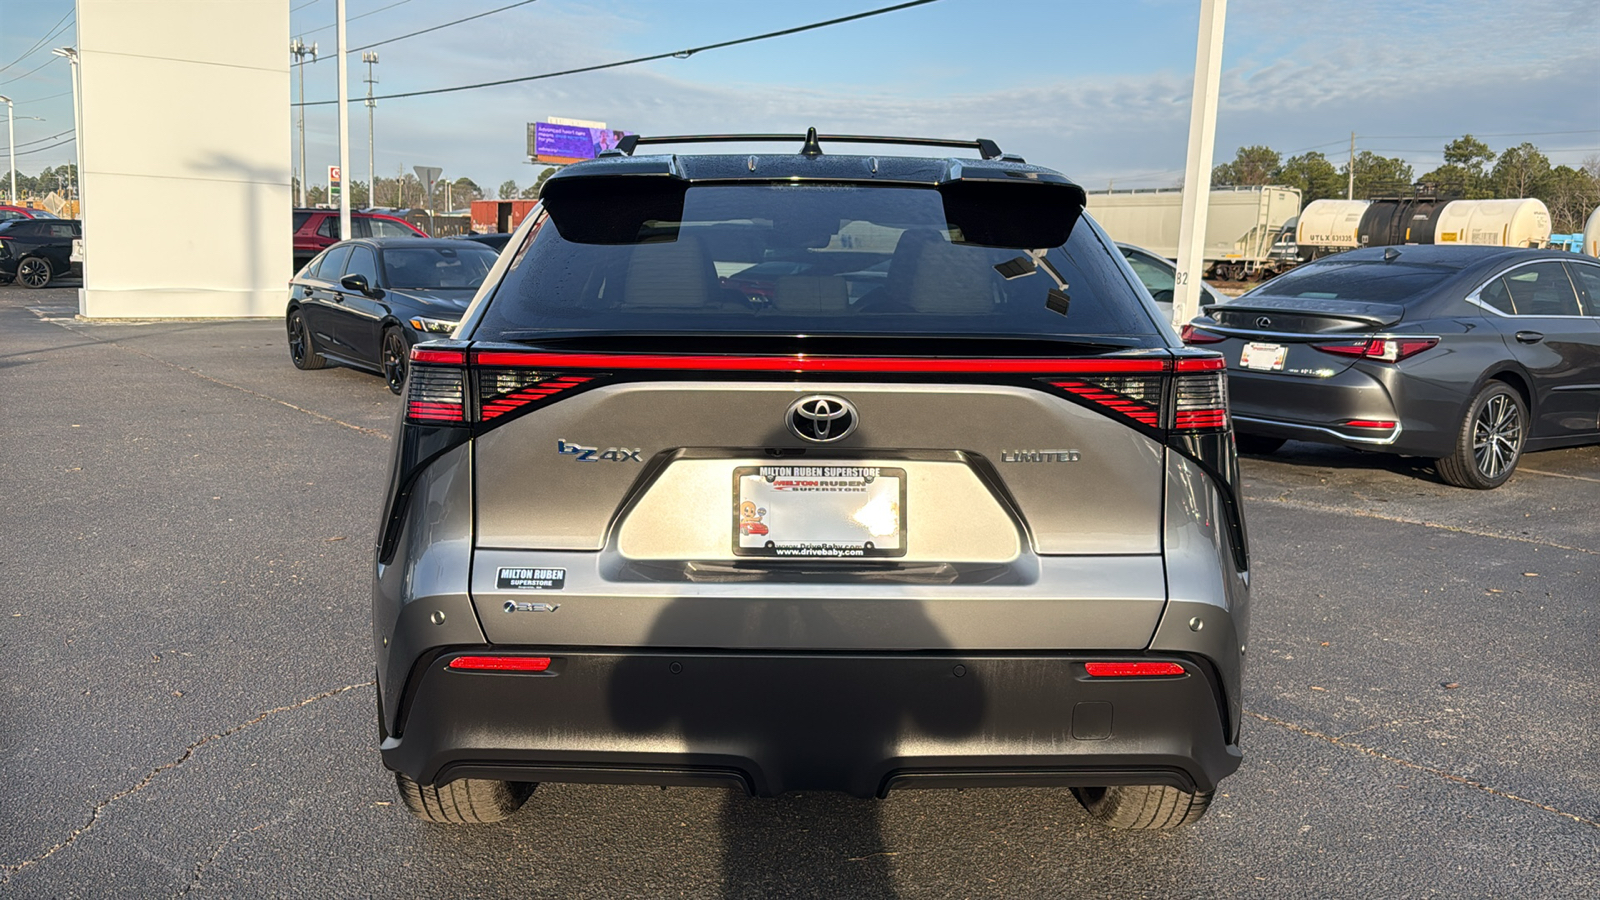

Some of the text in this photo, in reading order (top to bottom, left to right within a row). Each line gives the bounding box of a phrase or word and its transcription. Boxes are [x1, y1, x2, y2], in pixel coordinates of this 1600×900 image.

[1001, 449, 1081, 462] LIMITED
[760, 467, 880, 477] MILTON RUBEN SUPERSTORE
[776, 548, 864, 557] www.drivebaby.com
[501, 569, 564, 580] MILTON RUBEN
